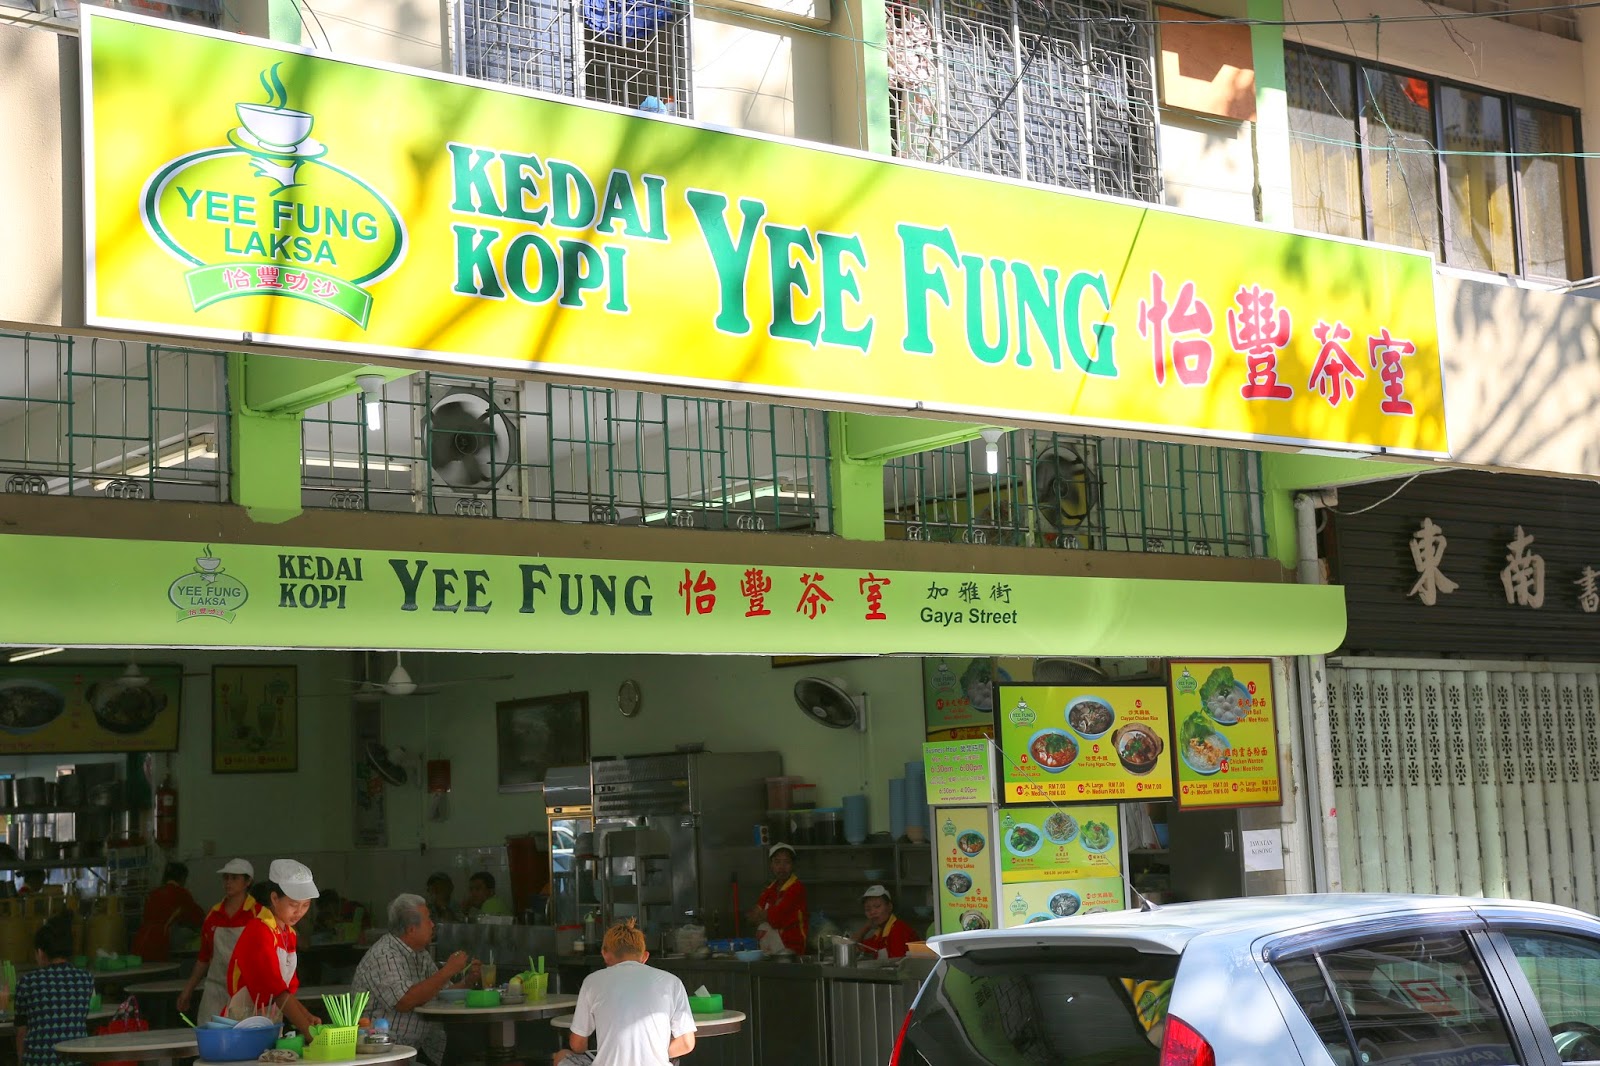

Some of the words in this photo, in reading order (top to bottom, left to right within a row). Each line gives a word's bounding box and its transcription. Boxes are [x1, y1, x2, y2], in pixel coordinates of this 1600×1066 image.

[176, 186, 256, 226] YEE
[273, 198, 378, 241] FUNG
[446, 142, 668, 242] KEDAI
[224, 227, 337, 266] LAKSA
[452, 225, 631, 314] KOPI
[685, 188, 874, 352] YEE
[897, 222, 1119, 378] FUNG
[1138, 271, 1417, 415] 怡豐茶室
[278, 554, 363, 581] KEDAI
[388, 559, 492, 614] YEE
[518, 563, 653, 616] FUNG
[178, 586, 202, 596] YEE
[207, 587, 241, 598] FUNG
[190, 597, 227, 606] LAKSA
[278, 583, 346, 609] KOPI
[678, 568, 891, 620] 怡豐茶室
[927, 580, 1013, 604] 加雅街
[920, 607, 964, 627] Gaya
[969, 607, 1018, 625] Street
